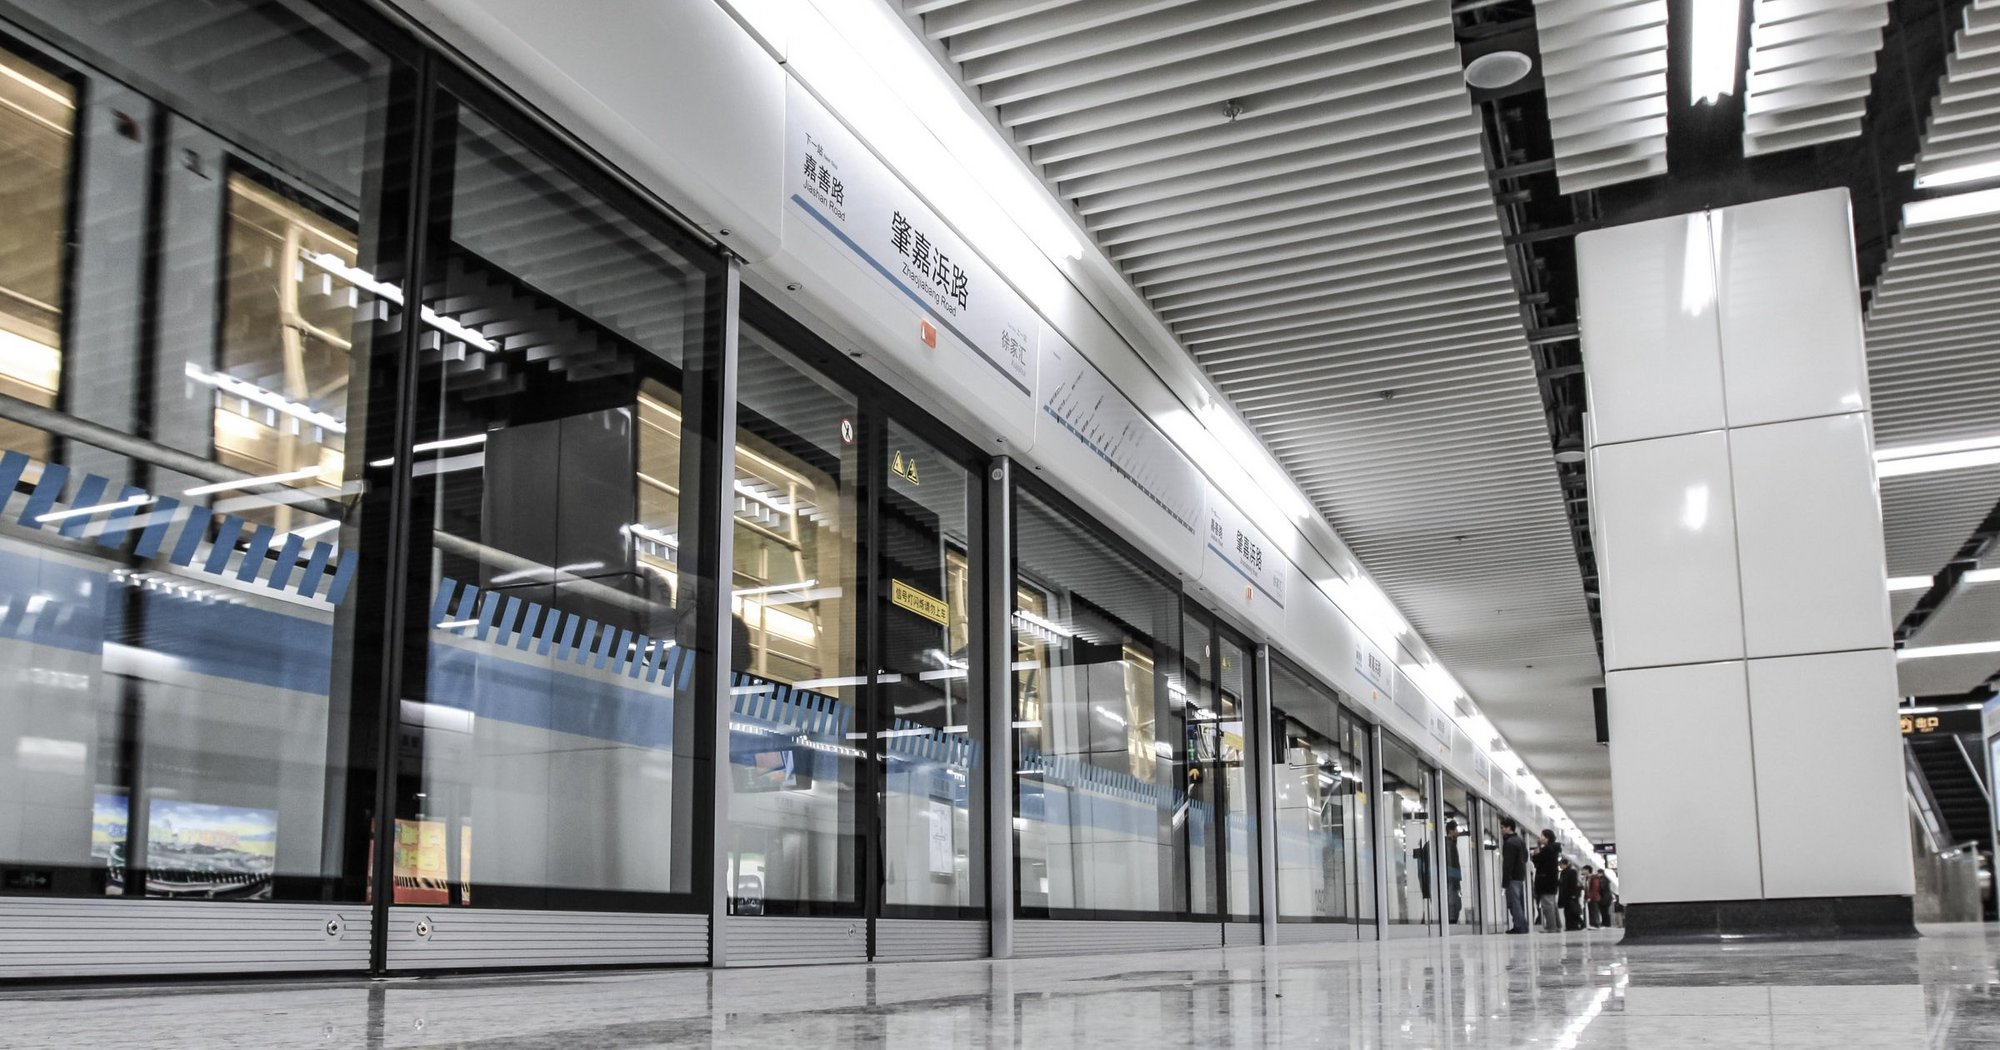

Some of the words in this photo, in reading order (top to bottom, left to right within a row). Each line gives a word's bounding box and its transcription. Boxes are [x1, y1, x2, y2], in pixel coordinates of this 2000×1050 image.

[803, 152, 845, 207] 嘉善路
[803, 179, 828, 207] Jiashan
[828, 200, 846, 222] Road
[891, 210, 969, 312] 肇嘉浜路
[902, 261, 940, 305] Zhaojiabang
[940, 294, 957, 317] Road
